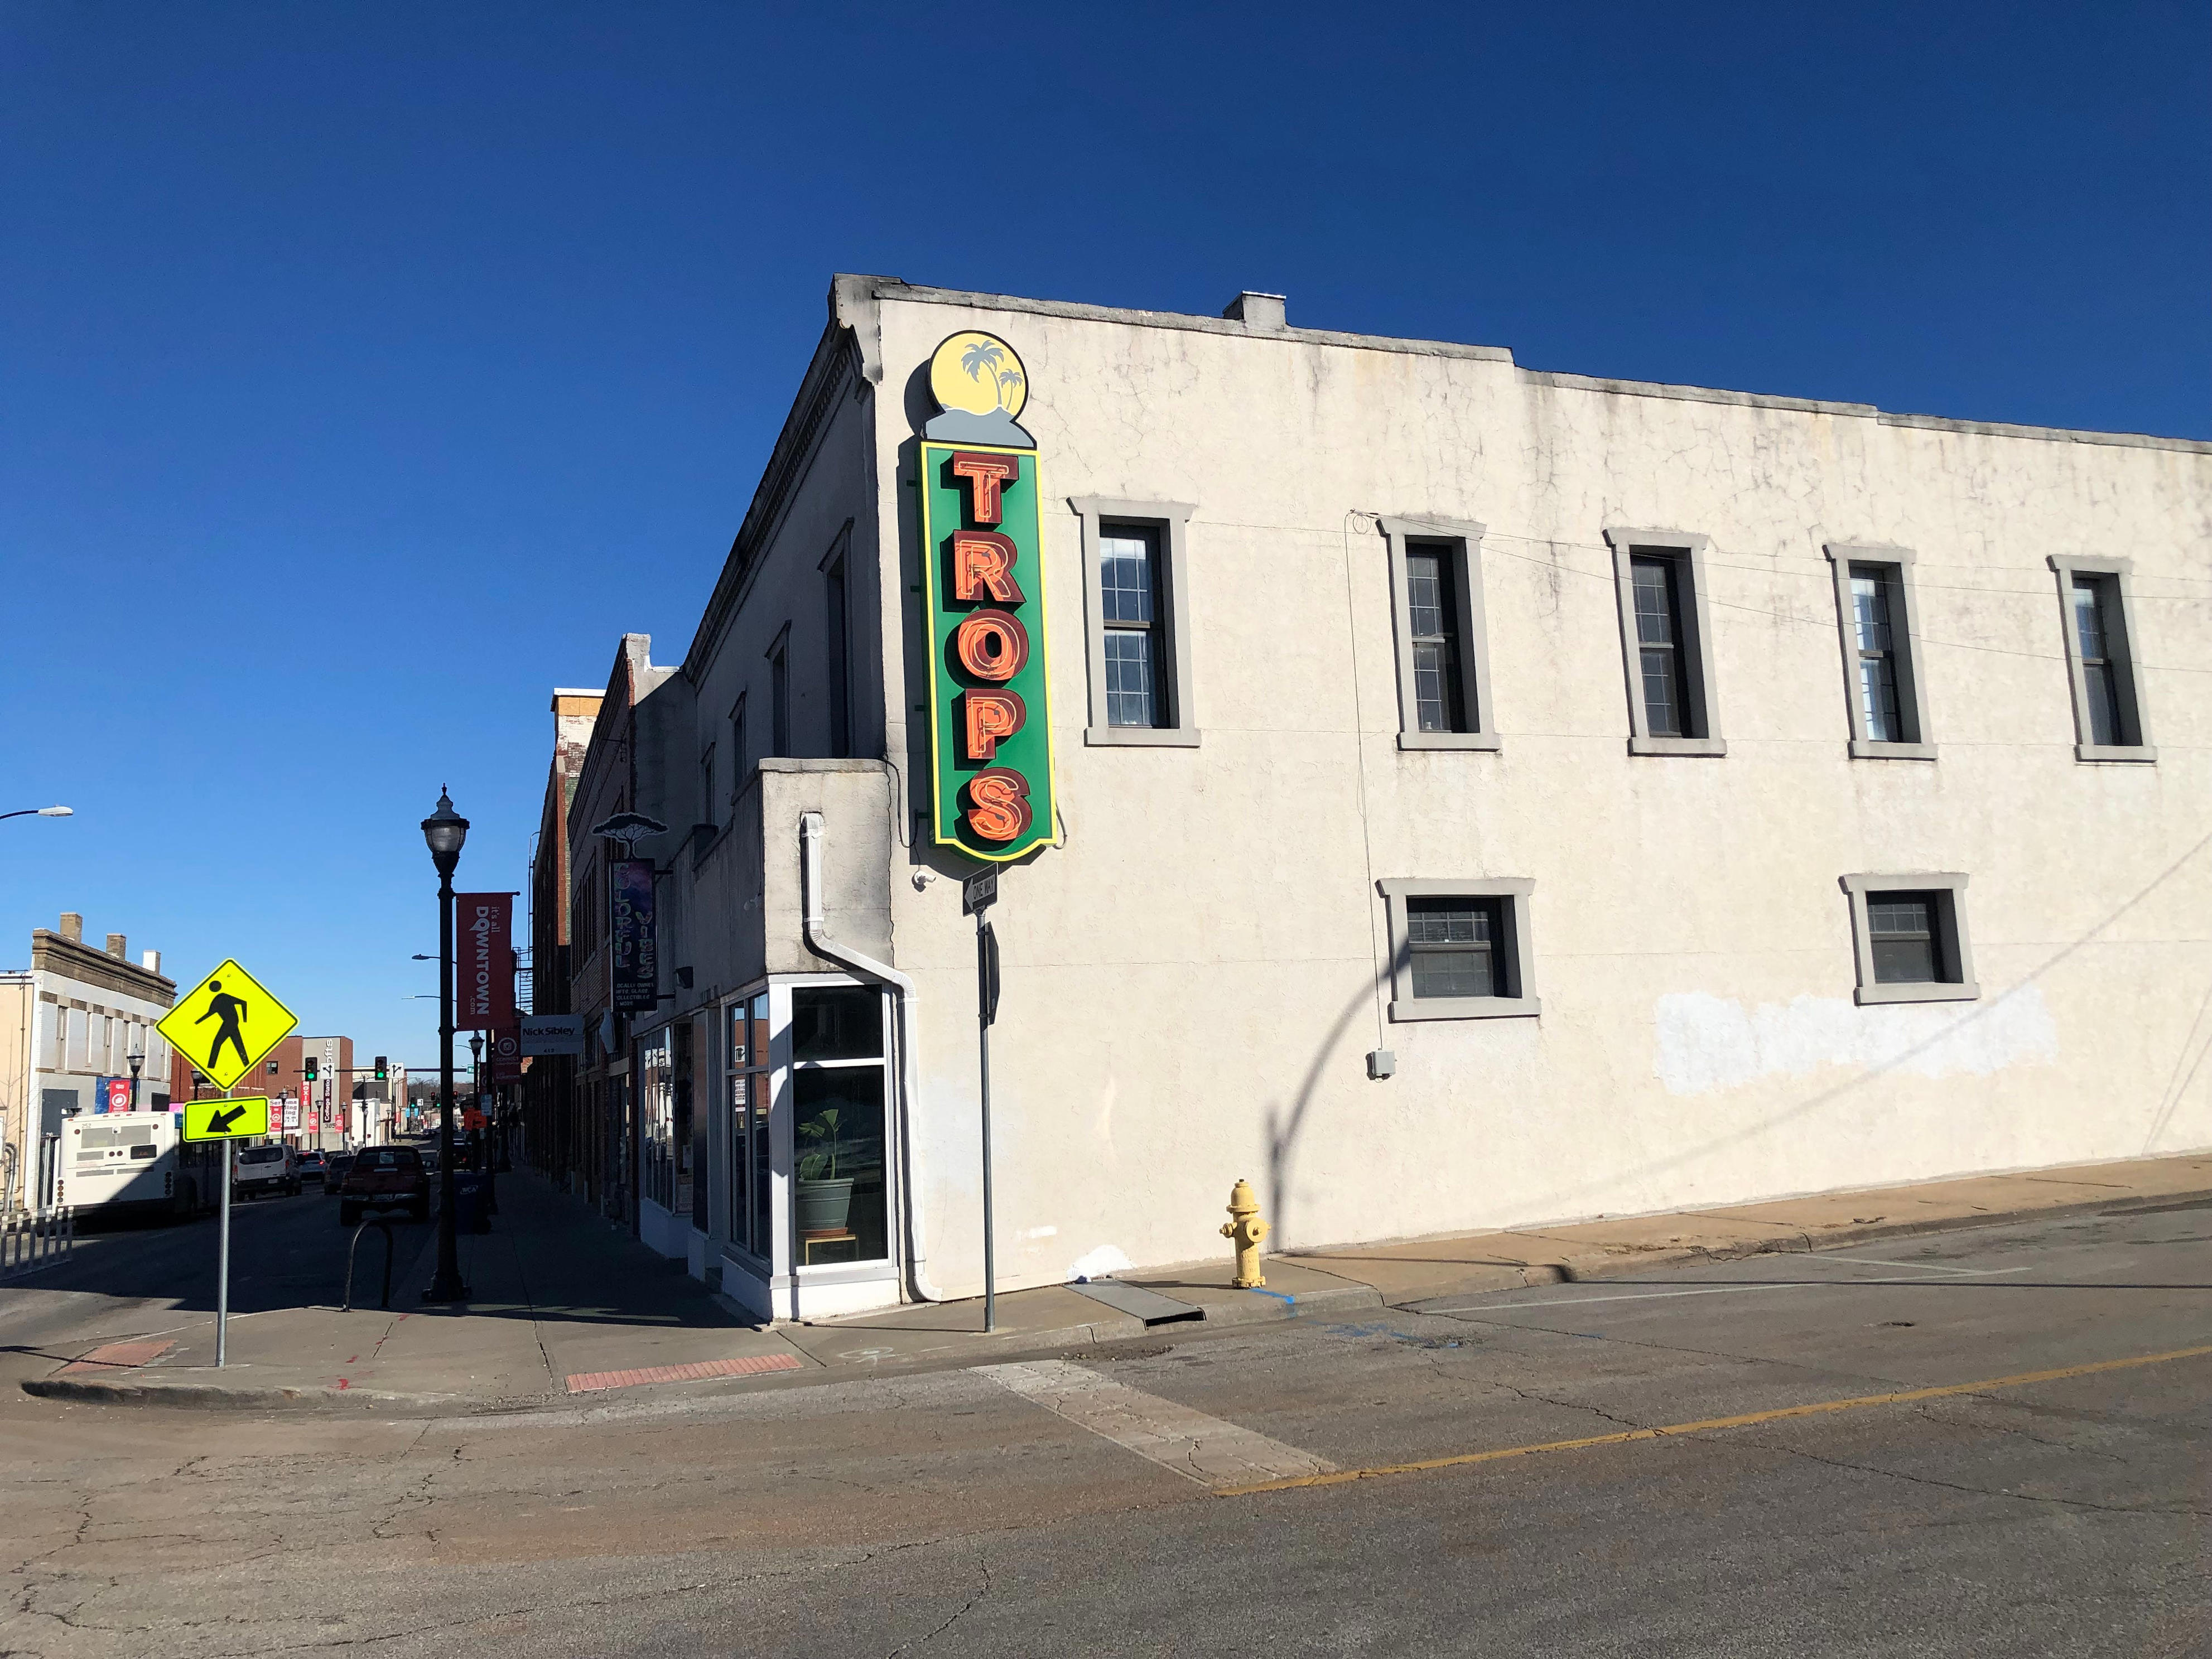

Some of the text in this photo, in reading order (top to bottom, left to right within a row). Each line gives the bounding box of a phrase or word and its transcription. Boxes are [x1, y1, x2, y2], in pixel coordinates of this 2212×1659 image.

[953, 452, 1033, 842] TROPS
[614, 862, 633, 968] COLORFUL
[974, 876, 994, 900] ONE WAY
[469, 906, 489, 1015] DOWNTOWN
[491, 921, 500, 933] all
[635, 911, 654, 978] VIBES
[523, 1027, 575, 1036] Nick Sibley
